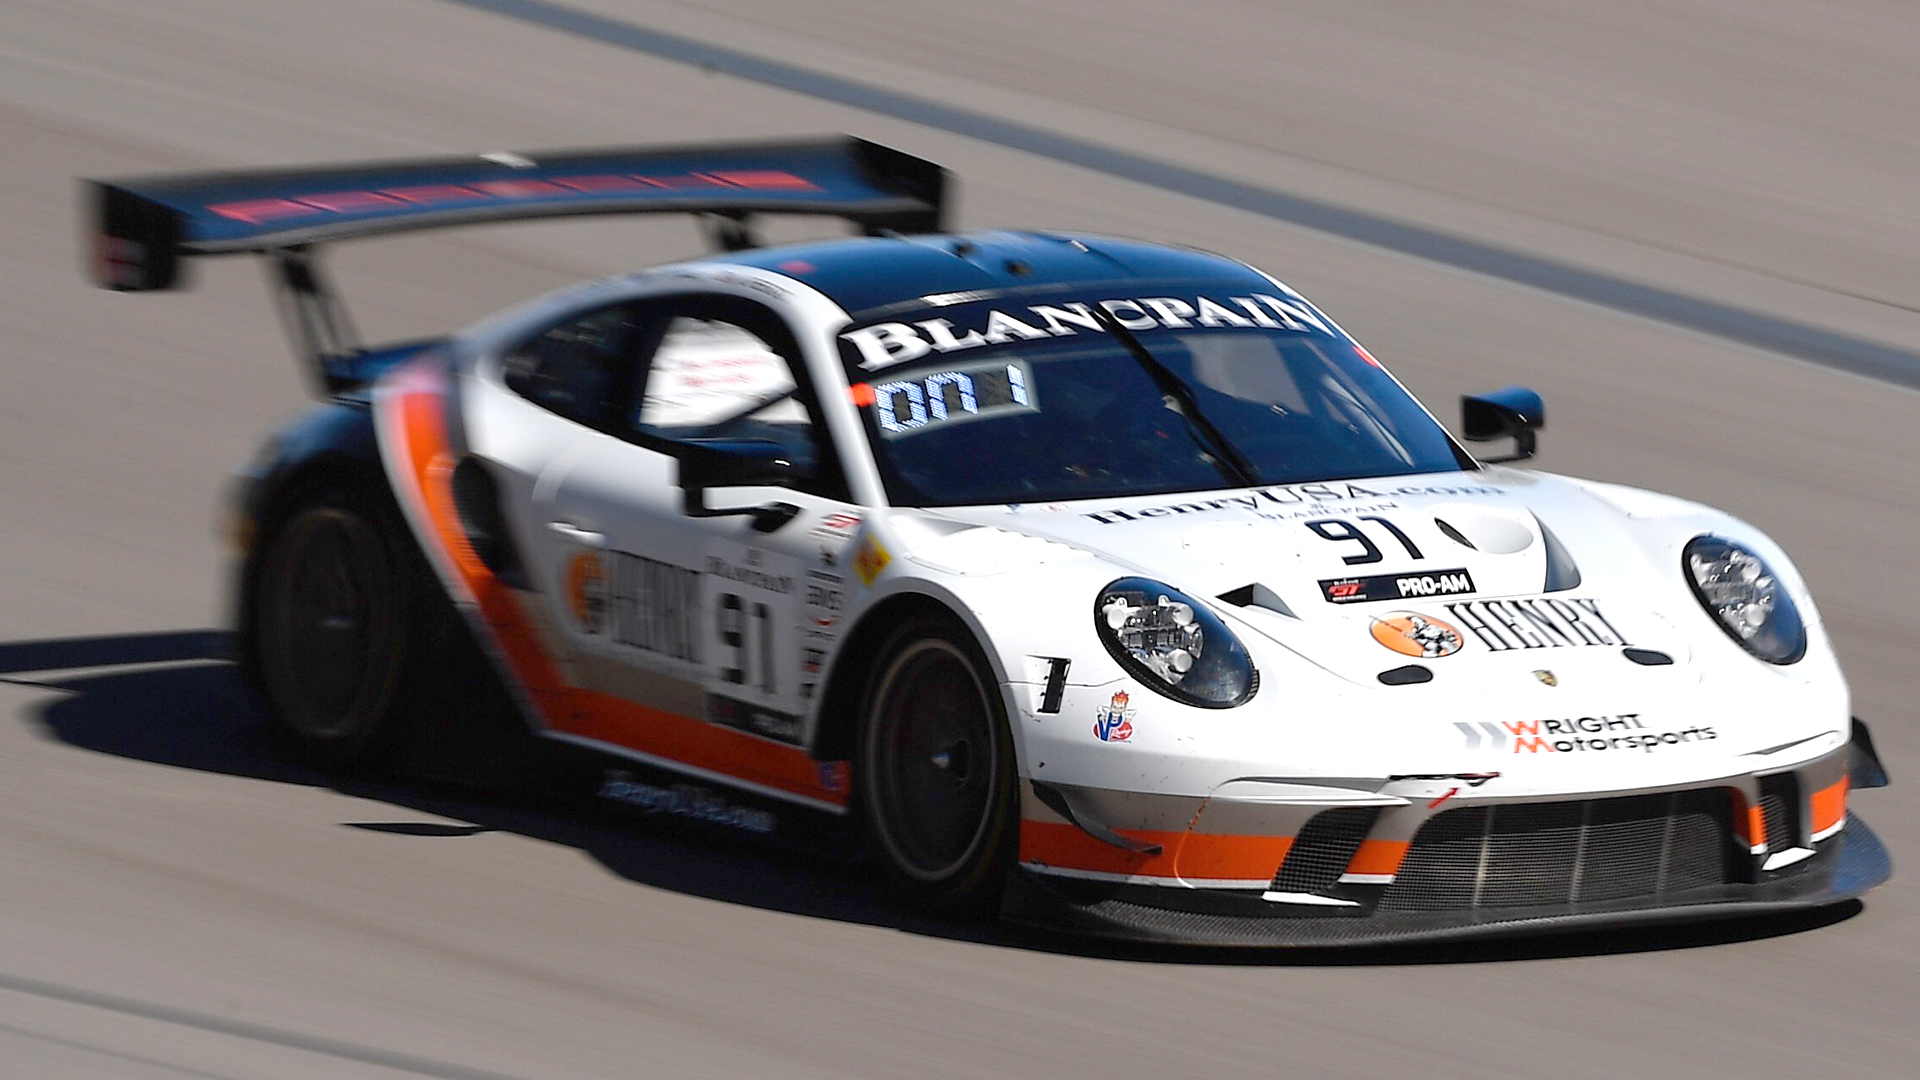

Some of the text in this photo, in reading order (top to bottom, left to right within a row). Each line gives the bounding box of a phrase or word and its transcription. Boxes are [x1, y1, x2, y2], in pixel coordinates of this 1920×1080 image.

[1304, 515, 1426, 567] 91
[1396, 572, 1471, 597] PRO-AM
[1444, 598, 1636, 652] HENRY
[1501, 713, 1647, 736] WRIGHT
[1512, 725, 1719, 755] Motorsports
